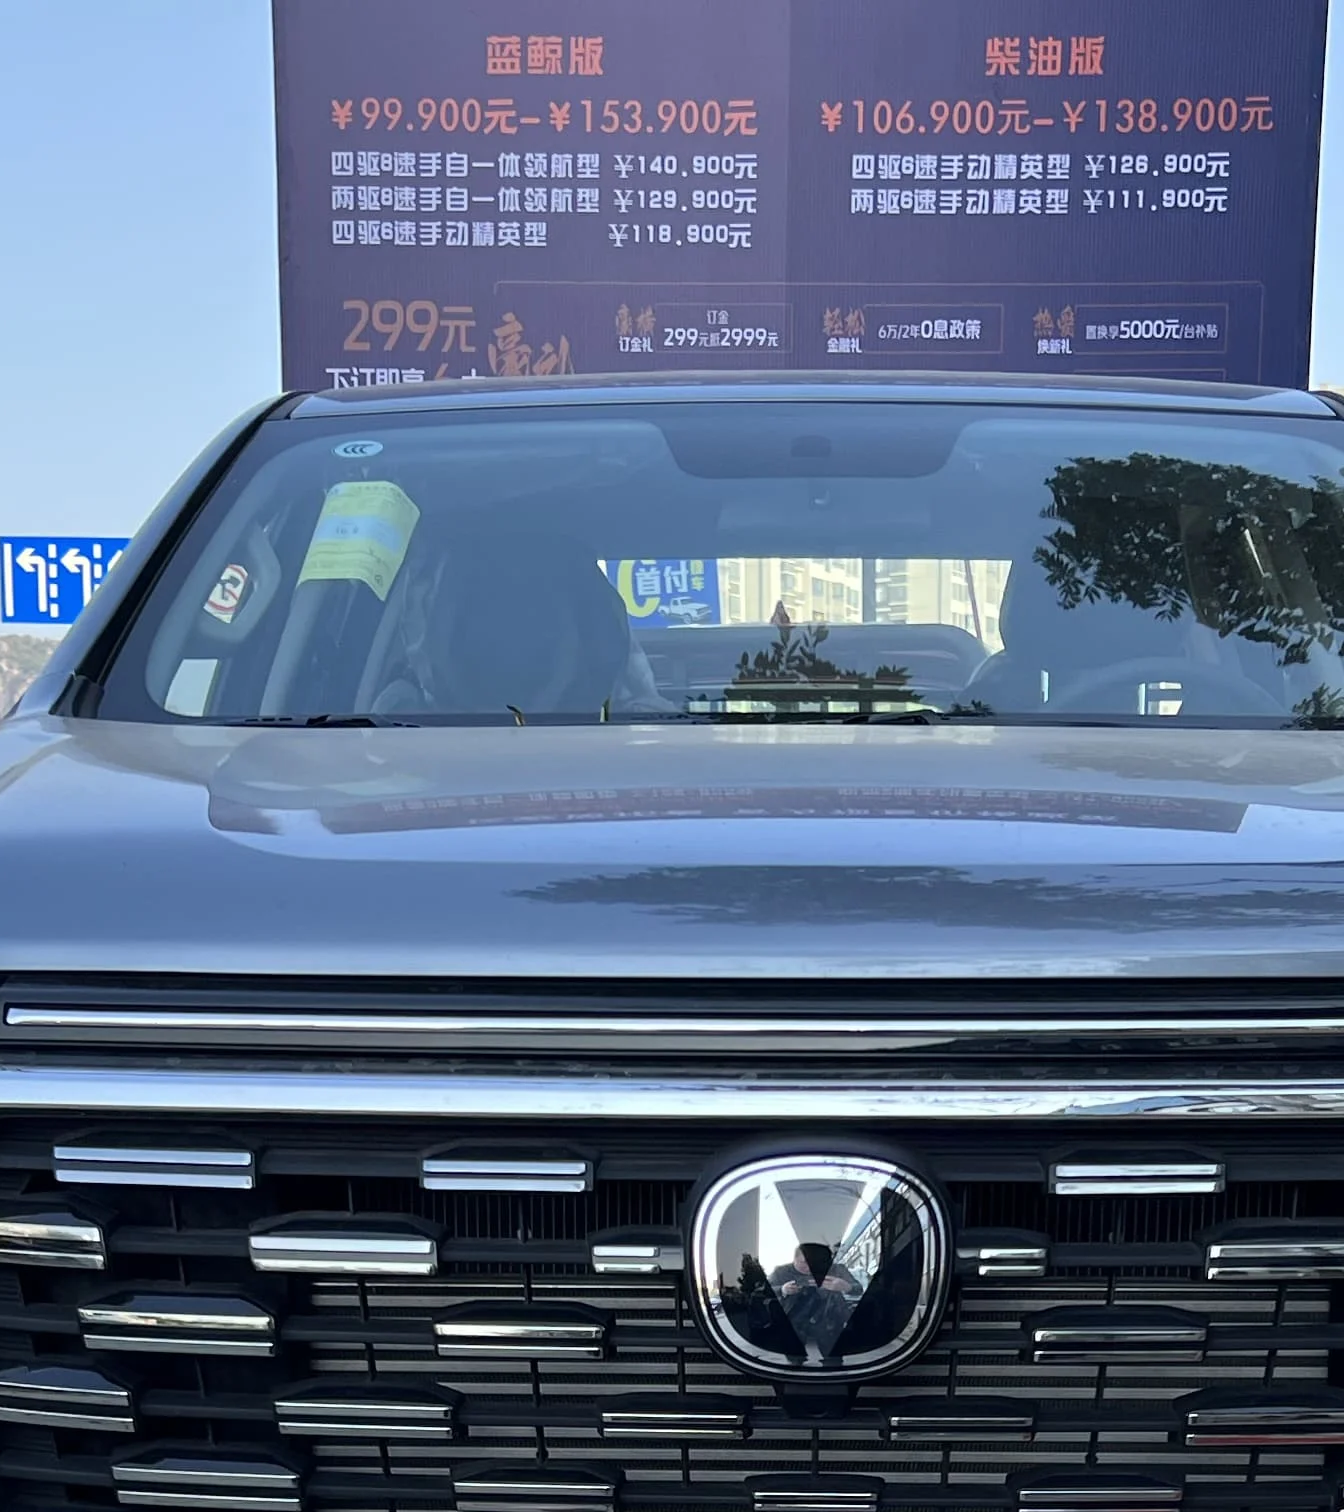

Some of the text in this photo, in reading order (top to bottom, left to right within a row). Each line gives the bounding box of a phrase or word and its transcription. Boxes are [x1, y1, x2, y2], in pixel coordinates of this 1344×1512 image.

[486, 36, 603, 76] 蓝鲸版
[985, 36, 1105, 77] 柴油版
[331, 152, 600, 179] 四驱8速手自一体领航型
[851, 154, 1070, 180] 四驱6速手动精英型
[331, 186, 600, 213] 两驱8速手自一体领航型
[850, 188, 1069, 214] 两驱6速手动精英型
[332, 220, 547, 247] 四驱6速手动精英型
[343, 300, 476, 352] 299元
[707, 310, 728, 325] 订金
[619, 336, 654, 353] 订金礼
[827, 337, 863, 353] 金融礼
